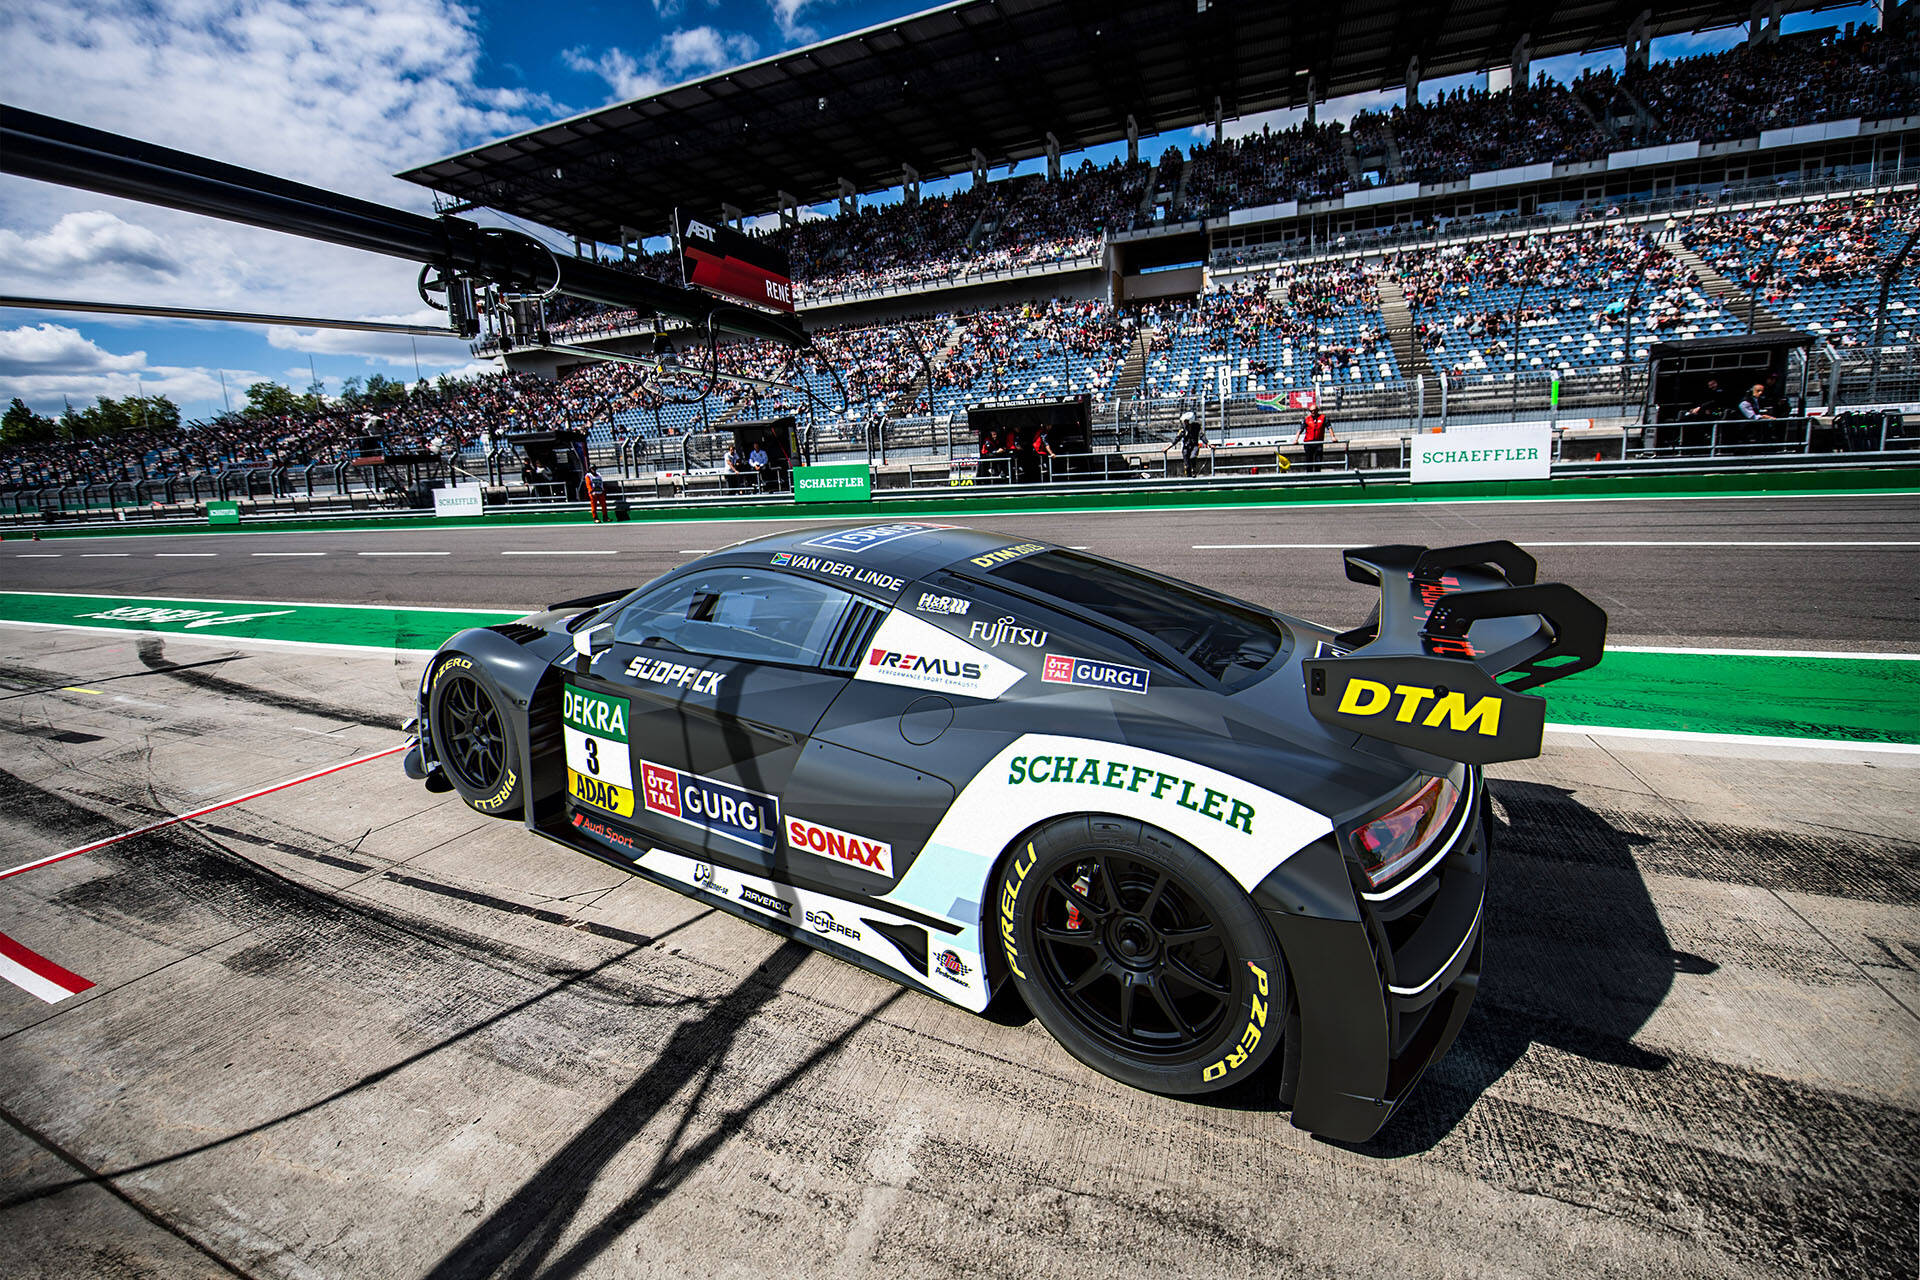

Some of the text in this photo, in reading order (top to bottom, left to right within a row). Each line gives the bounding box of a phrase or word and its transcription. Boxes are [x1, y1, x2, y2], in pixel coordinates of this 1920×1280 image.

[685, 219, 716, 242] ABT
[765, 279, 792, 304] RENÉ
[1422, 447, 1539, 464] SCHAEFFLER
[799, 477, 864, 489] SCHAEFFLER
[790, 554, 905, 592] VAN DER LINDE
[968, 616, 1049, 648] FUJITSU
[624, 655, 727, 696] SÜDPACK
[880, 651, 982, 680] REMUS
[1047, 669, 1068, 679] TAL
[1048, 658, 1070, 670] ÖTZ
[1076, 664, 1143, 687] GURGL
[564, 690, 626, 736] DEKRA
[1337, 678, 1503, 737] DTM
[585, 737, 600, 776] 3
[474, 768, 517, 810] PIRELLI
[576, 774, 619, 811] ADAC
[647, 769, 674, 793] ÖTZ
[1008, 755, 1256, 835] SCHAEFFLER
[649, 790, 676, 810] TAL
[684, 785, 775, 837] GURGL
[583, 817, 634, 849] Audi Sport
[790, 821, 886, 872] SONAX
[744, 889, 789, 912] RAVENOL
[1000, 841, 1038, 980] PIRELLI
[805, 911, 861, 941] SCHERER
